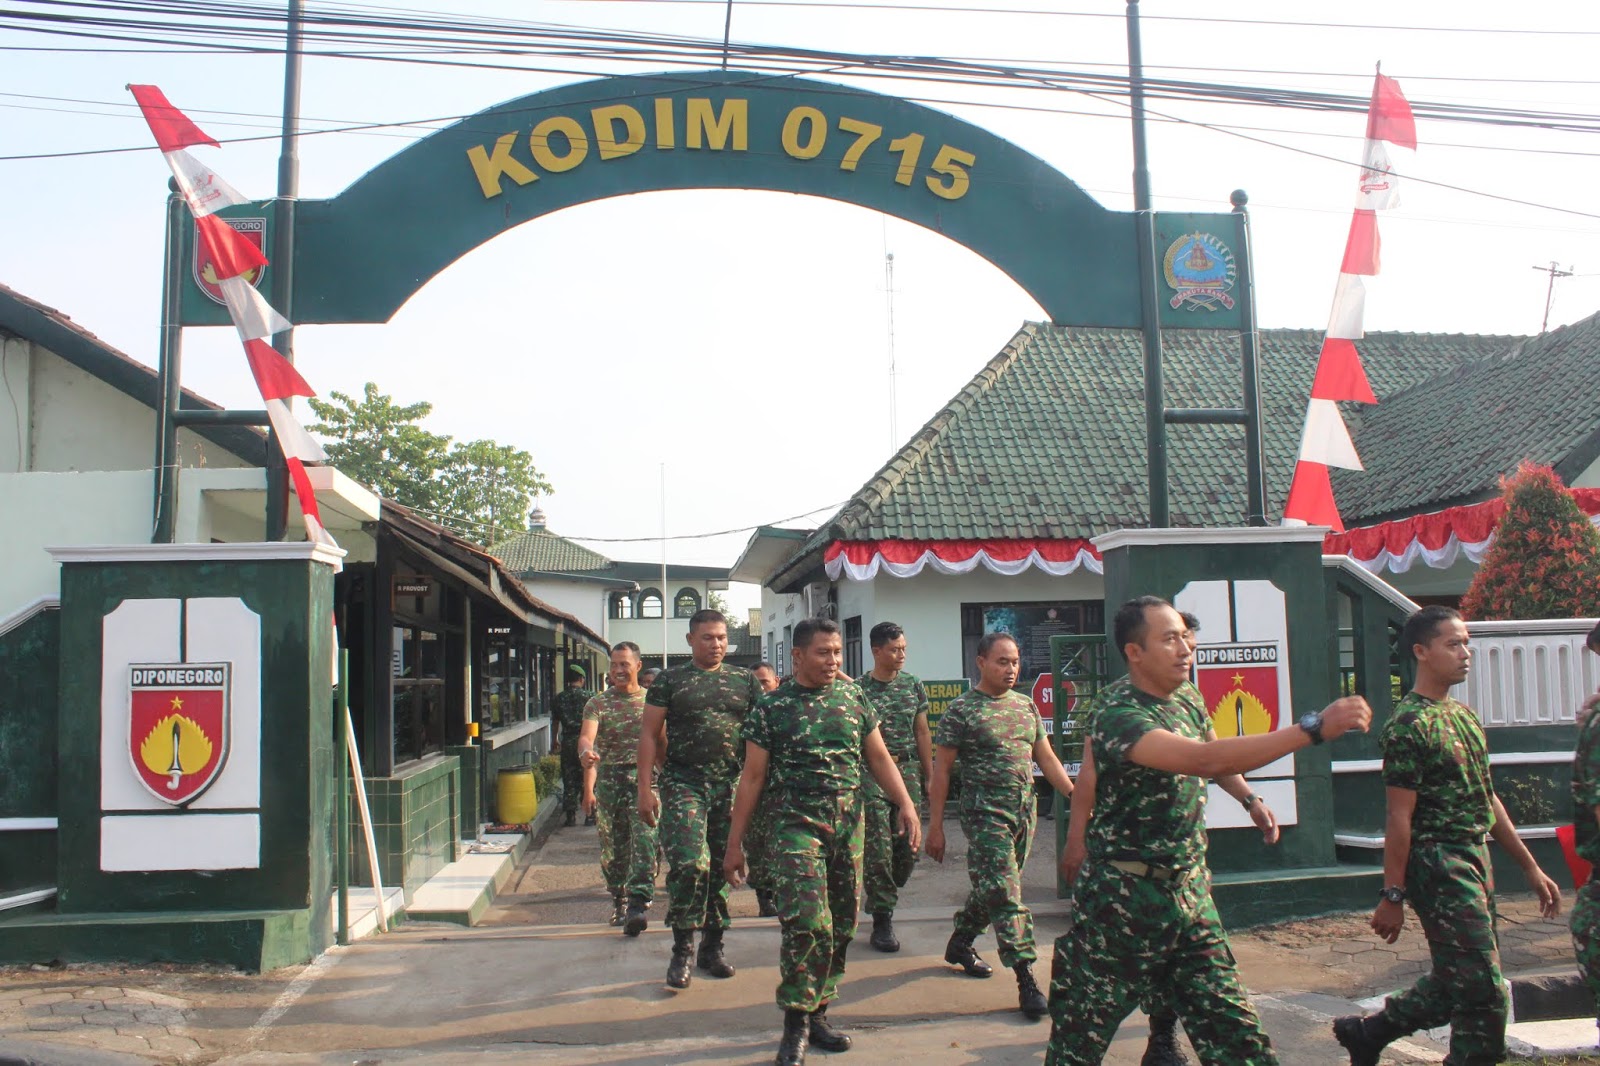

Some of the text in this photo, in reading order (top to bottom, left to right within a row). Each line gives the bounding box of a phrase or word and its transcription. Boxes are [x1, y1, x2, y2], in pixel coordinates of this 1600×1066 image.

[466, 98, 976, 200] KODIM 0715
[229, 222, 261, 230] EGORO
[1198, 648, 1276, 663] DIPONEGORO
[133, 670, 222, 684] DIPONEGORO
[924, 684, 962, 699] AERAH
